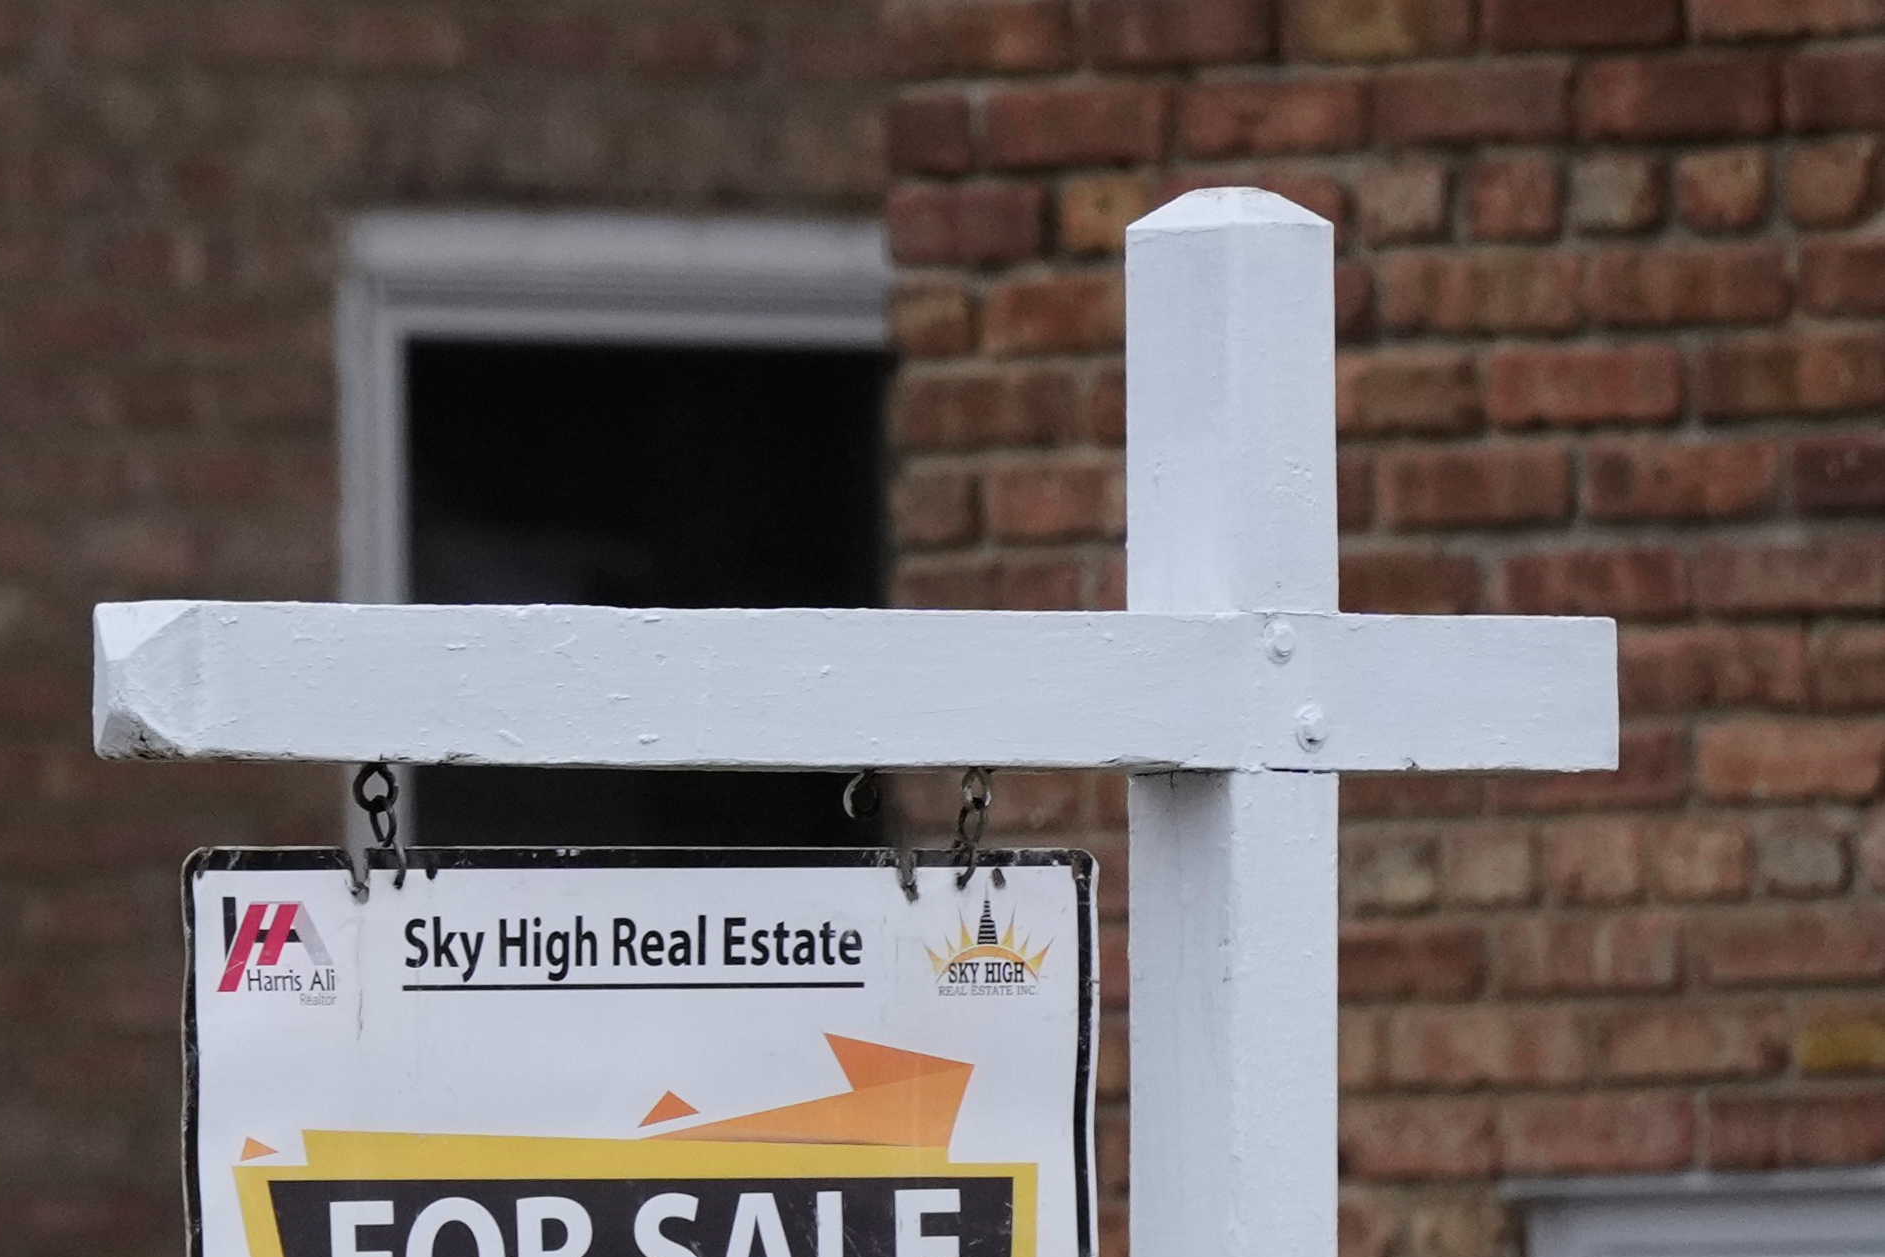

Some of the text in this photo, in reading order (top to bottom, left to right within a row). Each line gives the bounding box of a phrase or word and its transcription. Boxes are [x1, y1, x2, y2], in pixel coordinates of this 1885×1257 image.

[404, 914, 863, 983] Sky High Real Estate
[246, 968, 335, 992] Harris Ali
[948, 961, 1025, 983] SKY HIGH
[299, 993, 336, 1006] Realtor
[938, 984, 1039, 996] REAL ESTATE INC.
